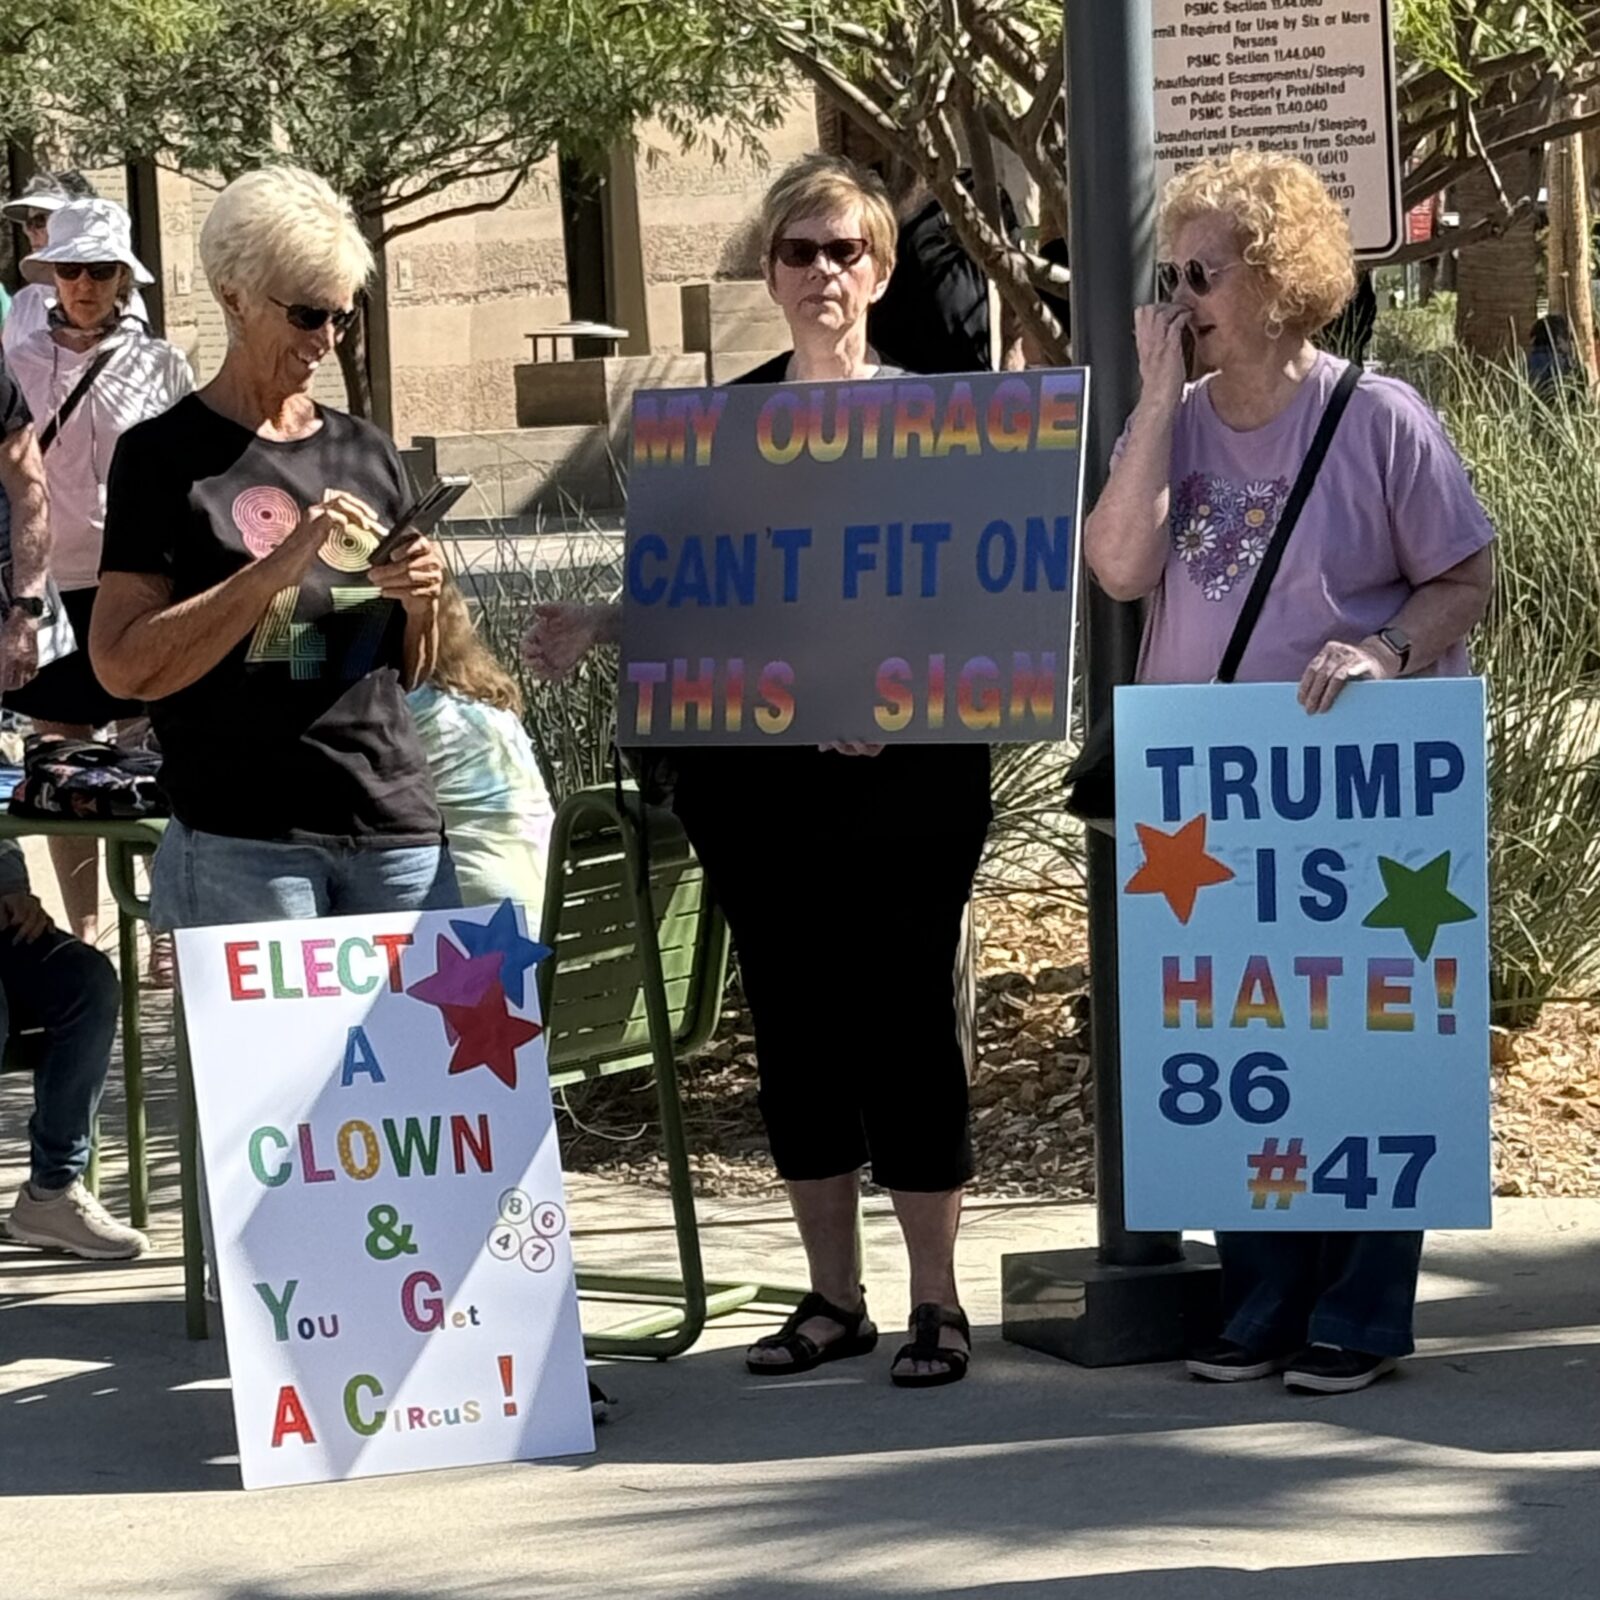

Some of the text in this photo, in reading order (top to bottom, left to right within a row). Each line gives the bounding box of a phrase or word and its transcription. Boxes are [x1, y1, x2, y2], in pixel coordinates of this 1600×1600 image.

[1152, 11, 1370, 38] rmit Required for Use by Six or More
[1184, 2, 1219, 16] PSMC
[1223, 1, 1267, 13] Section
[1187, 53, 1221, 68] PSMC
[1226, 51, 1270, 65] Section
[1233, 36, 1277, 49] Persons
[1171, 80, 1345, 106] on Public Property Prohibited
[1190, 106, 1224, 120] PSMC
[1228, 103, 1272, 118] Section
[1154, 144, 1204, 160] rohibited
[1258, 137, 1298, 152] Blocks
[1303, 136, 1330, 150] from
[1335, 131, 1376, 147] School
[632, 373, 1083, 468] MY OUTRAGE
[627, 516, 1071, 609] CAN'T FIT ON
[627, 651, 1057, 736] THIS SIGN
[1145, 740, 1465, 821] TRUMP
[1256, 848, 1348, 923] IS
[224, 933, 414, 1001] ELECT
[1162, 955, 1458, 1035] HATE!
[340, 1025, 385, 1087] A
[1158, 1051, 1290, 1126] 86
[248, 1114, 493, 1188] CLOWN
[1247, 1135, 1437, 1210] #47
[365, 1203, 418, 1260] &
[508, 1197, 556, 1229] 8 6
[495, 1233, 546, 1262] 4 7
[271, 1385, 317, 1448] A
